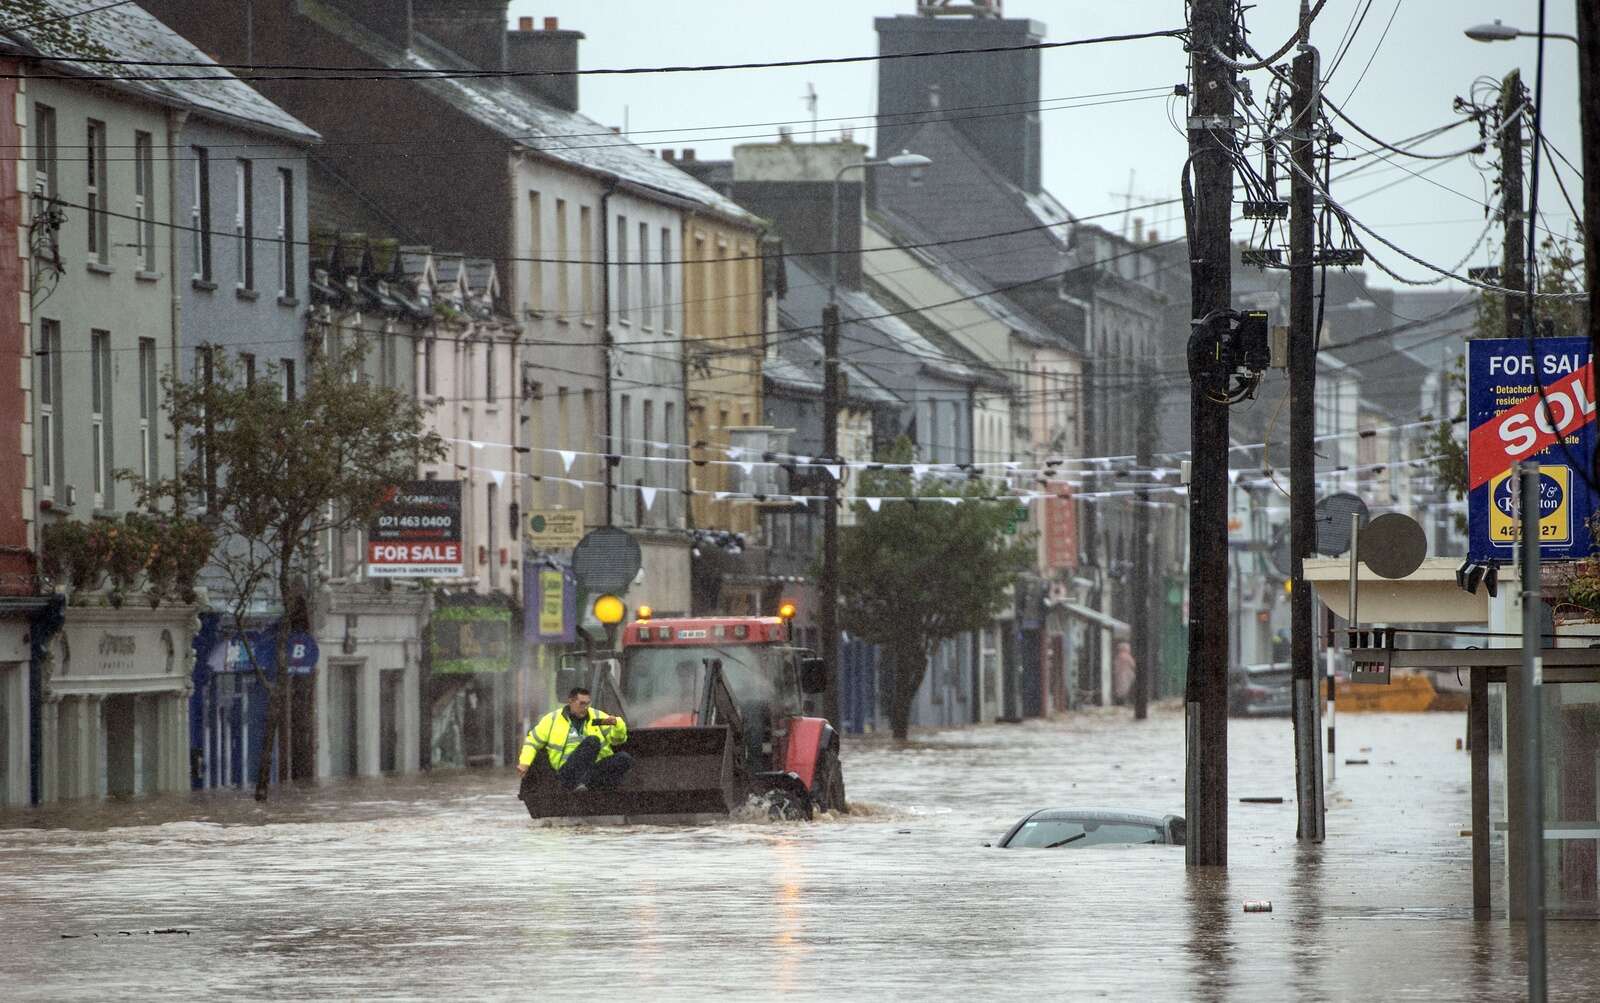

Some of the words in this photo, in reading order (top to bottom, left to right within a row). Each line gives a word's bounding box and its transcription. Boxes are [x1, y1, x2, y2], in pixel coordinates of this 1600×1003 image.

[1489, 355, 1535, 375] FOR
[1496, 385, 1532, 394] Detached
[1498, 377, 1596, 456] SOL
[1564, 434, 1580, 445] site
[400, 516, 420, 527] 463
[421, 516, 452, 527] 0400
[374, 545, 409, 561] FOR
[411, 545, 457, 561] SALE
